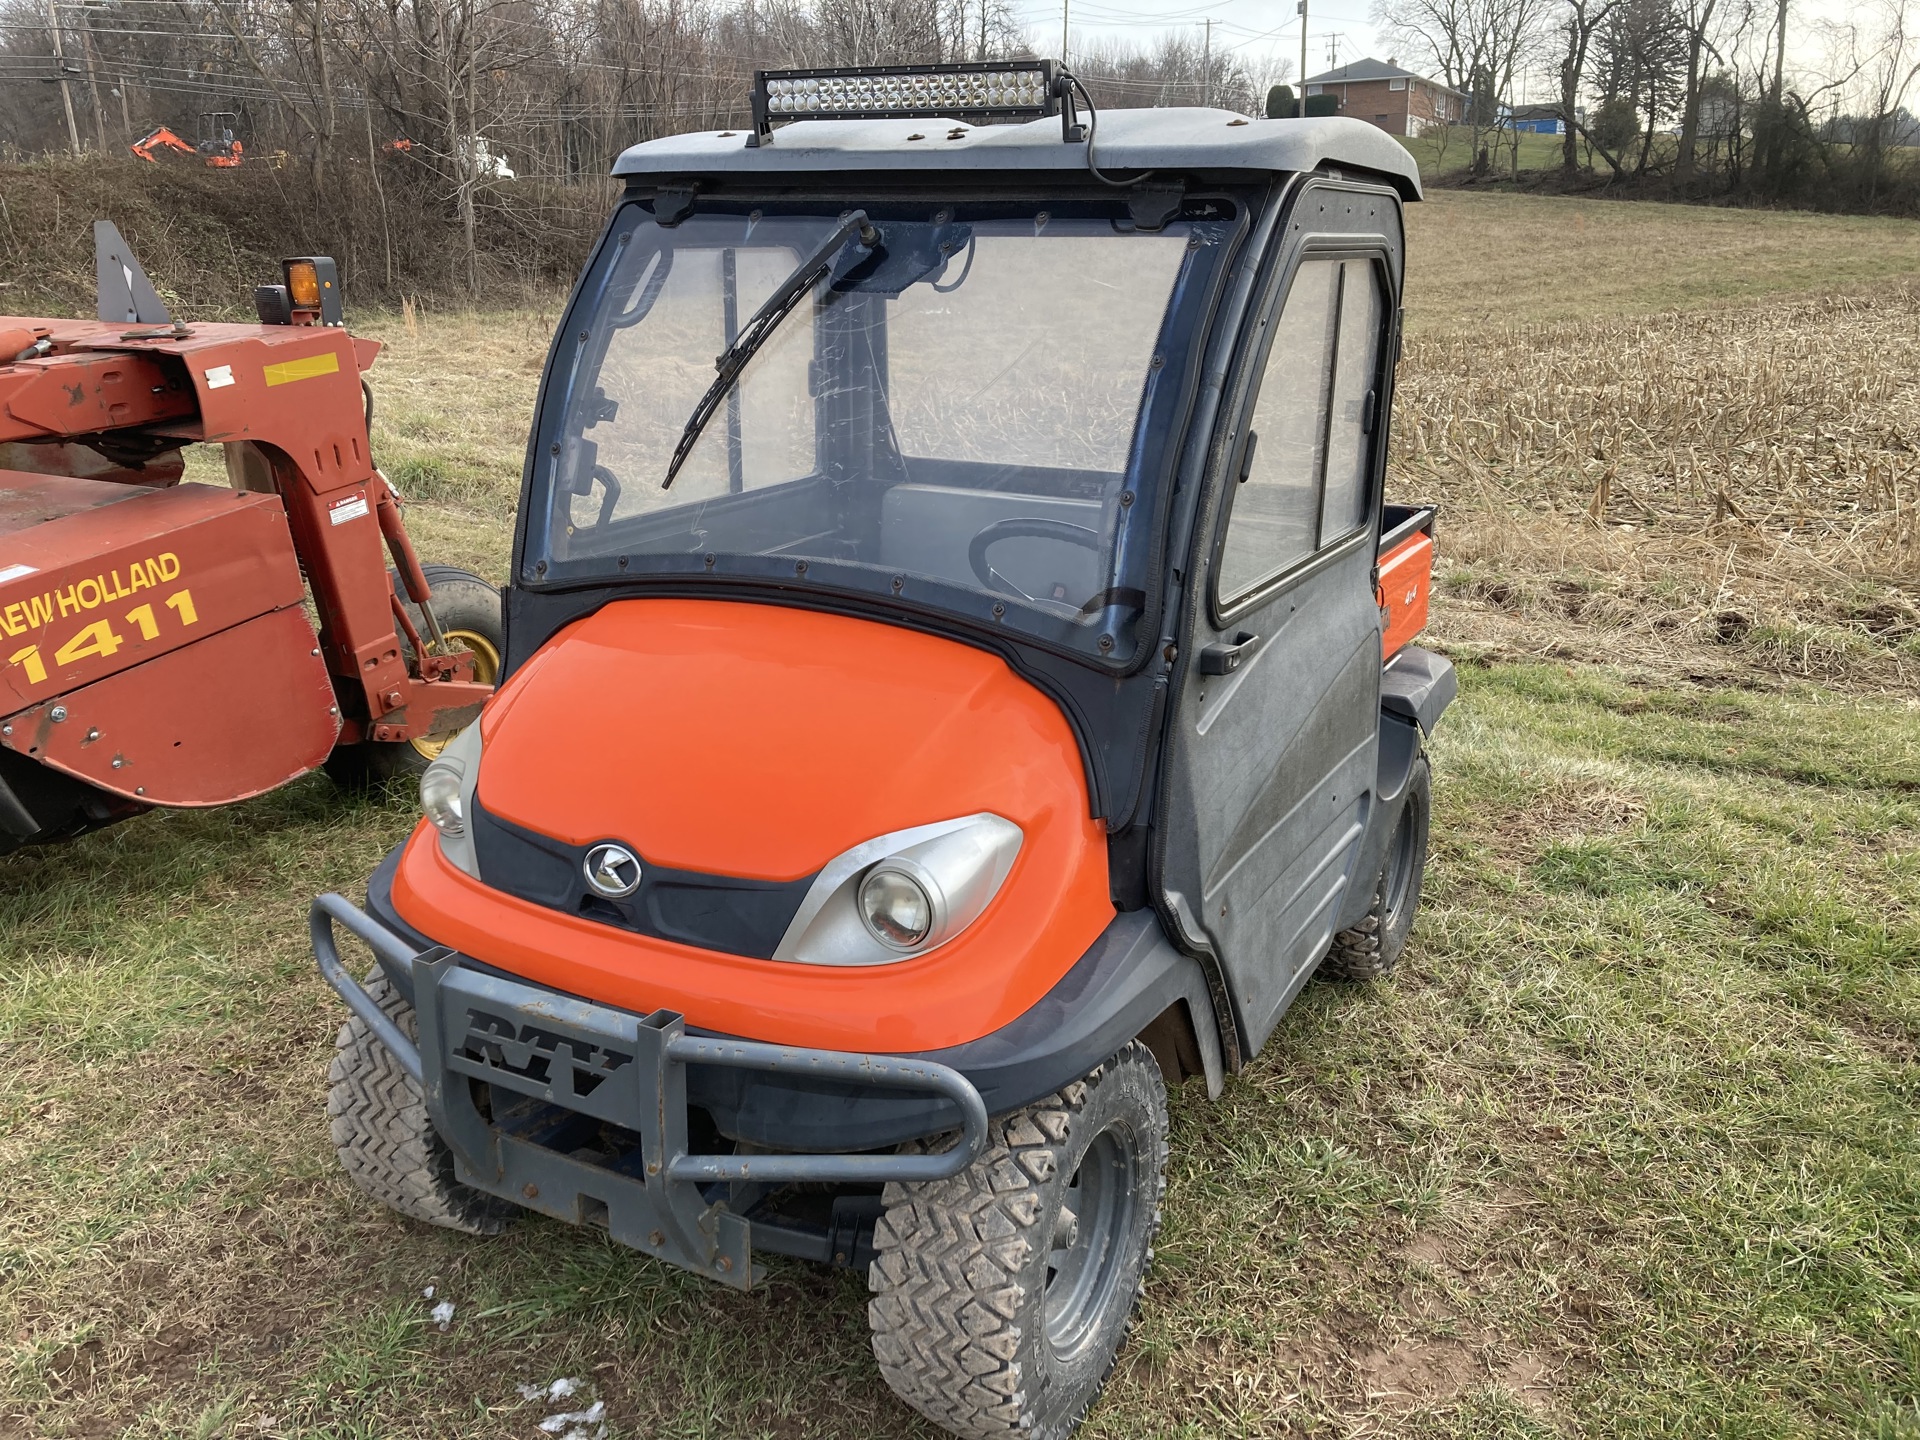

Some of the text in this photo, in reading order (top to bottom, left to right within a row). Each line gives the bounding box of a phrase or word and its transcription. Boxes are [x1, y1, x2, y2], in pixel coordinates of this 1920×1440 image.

[55, 553, 180, 618] HOLLAND
[9, 589, 198, 684] 1411
[453, 1008, 633, 1098] RTV
